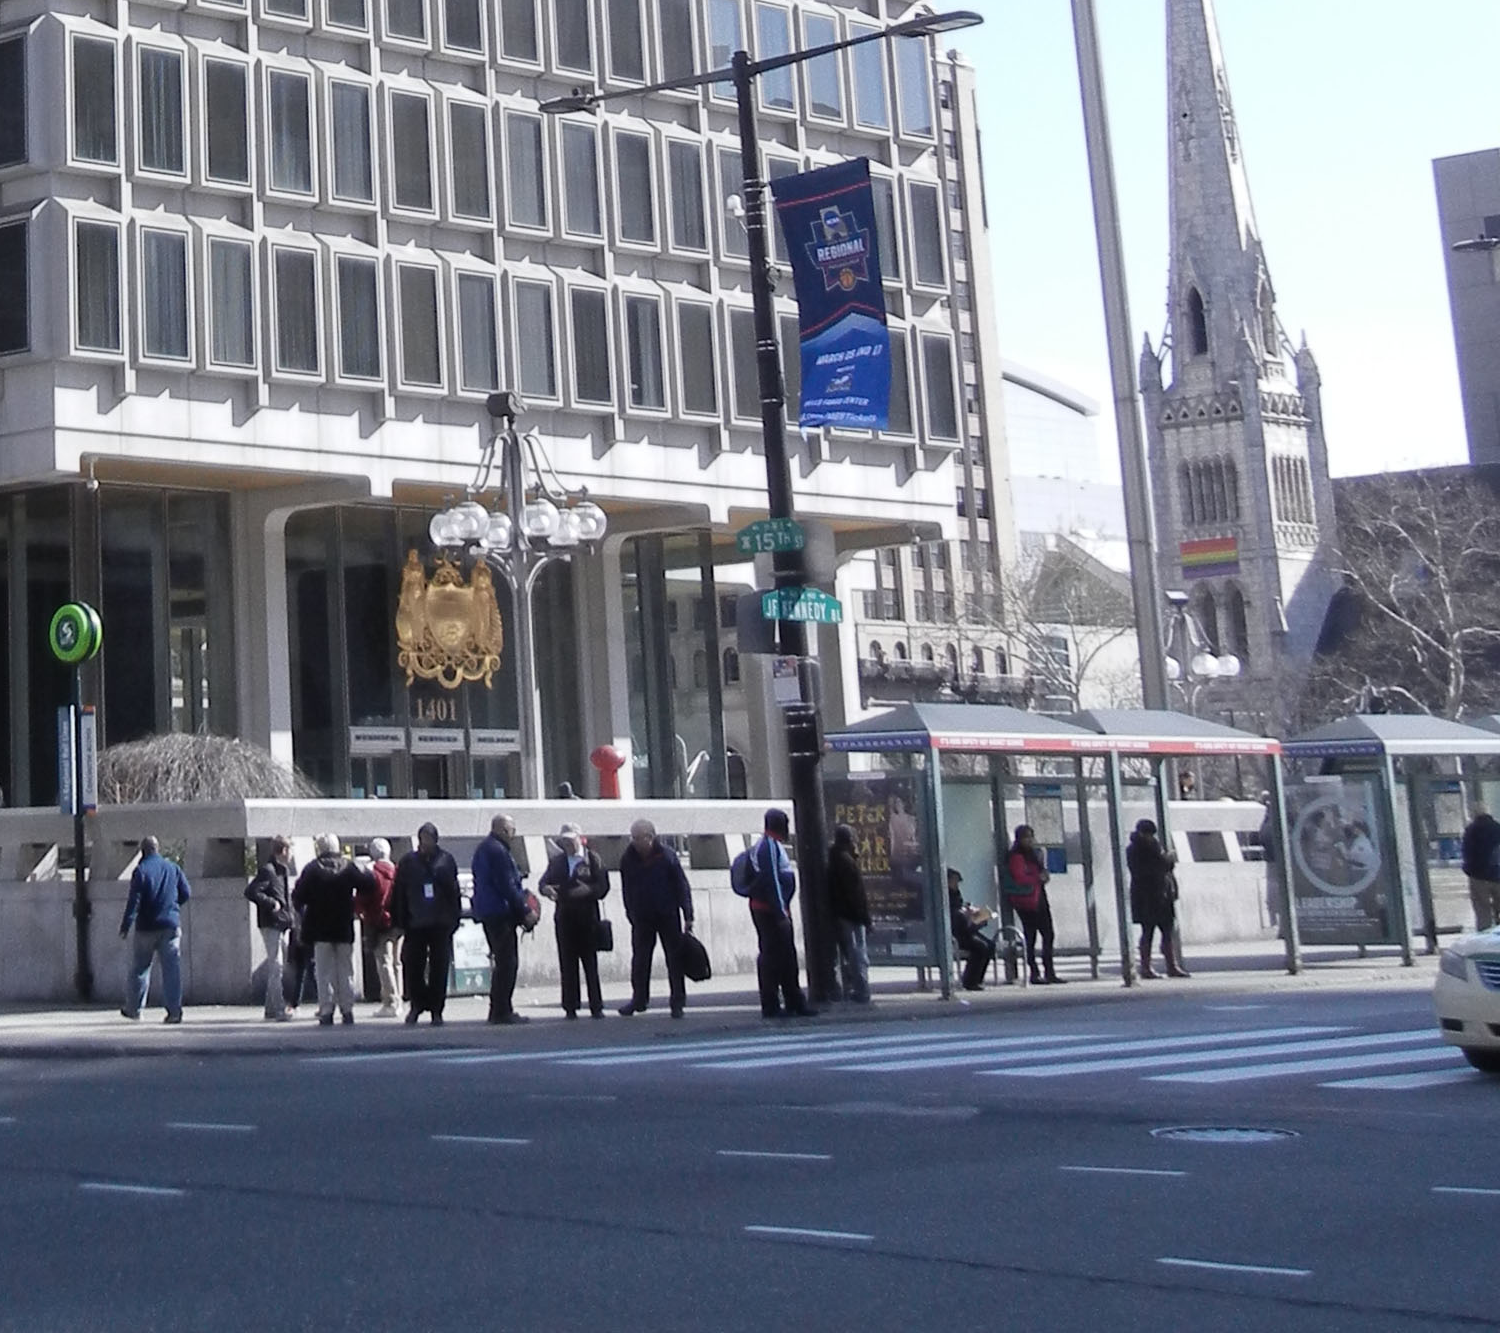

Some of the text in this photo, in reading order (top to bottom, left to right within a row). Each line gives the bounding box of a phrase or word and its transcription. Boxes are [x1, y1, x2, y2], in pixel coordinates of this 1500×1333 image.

[816, 237, 865, 262] REGIONAL
[765, 598, 779, 617] JF
[781, 600, 827, 621] KENNEDY
[417, 698, 457, 722] 1401
[835, 804, 886, 825] PETER
